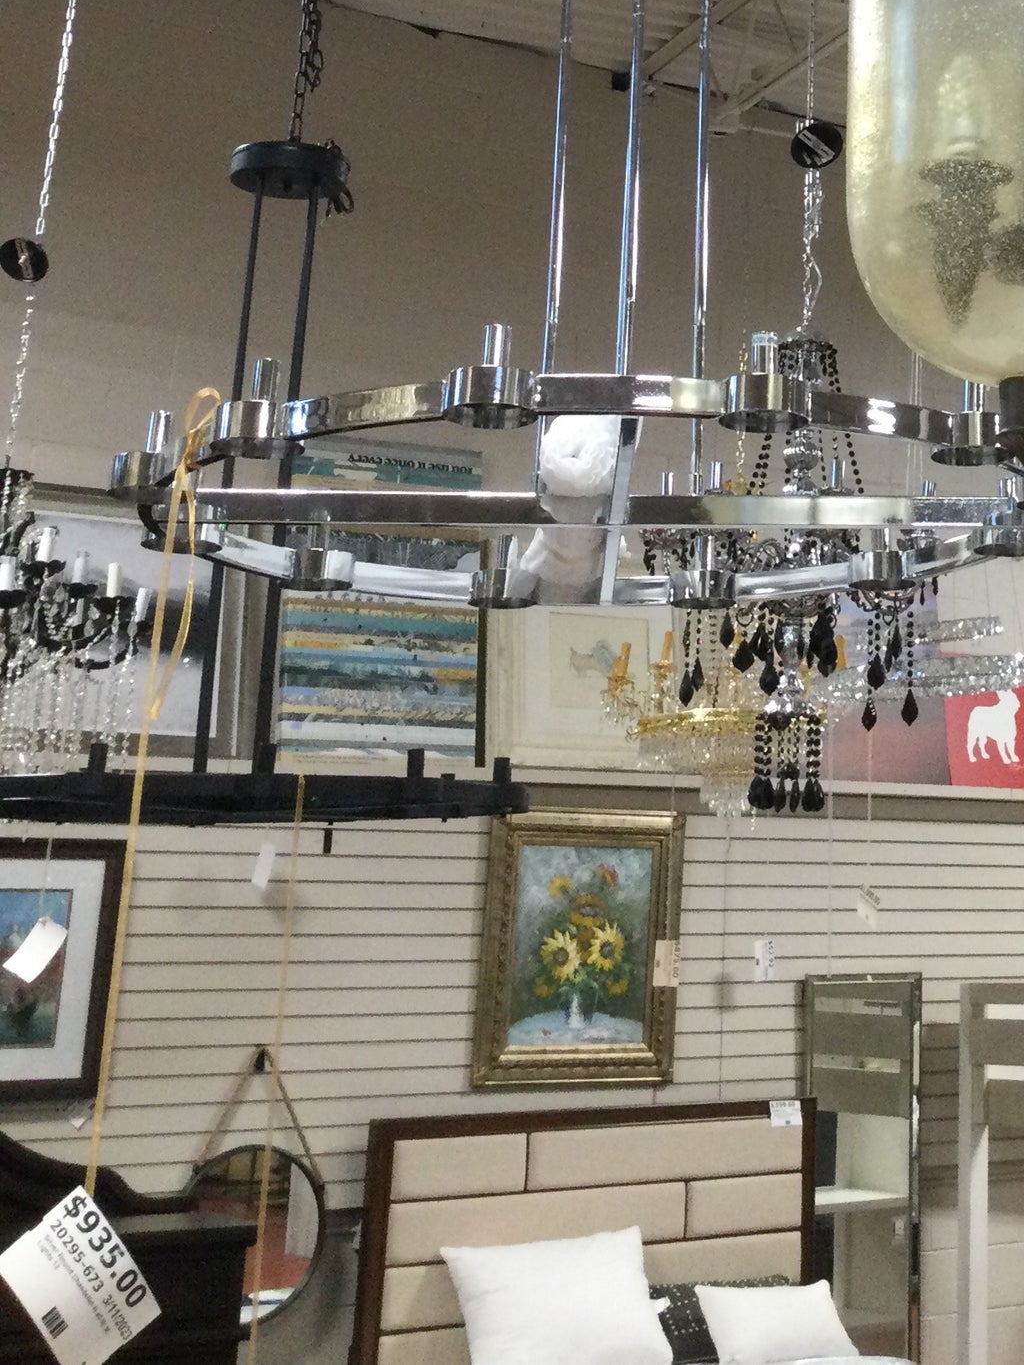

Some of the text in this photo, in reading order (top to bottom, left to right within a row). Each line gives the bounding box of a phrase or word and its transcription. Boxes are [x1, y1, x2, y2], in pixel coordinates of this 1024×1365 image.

[347, 453, 384, 466] every
[384, 456, 416, 468] once
[427, 462, 450, 472] use
[63, 1195, 147, 1308] $935.00
[50, 1218, 105, 1293] 20295-673
[102, 1294, 133, 1340] 3/11/2023
